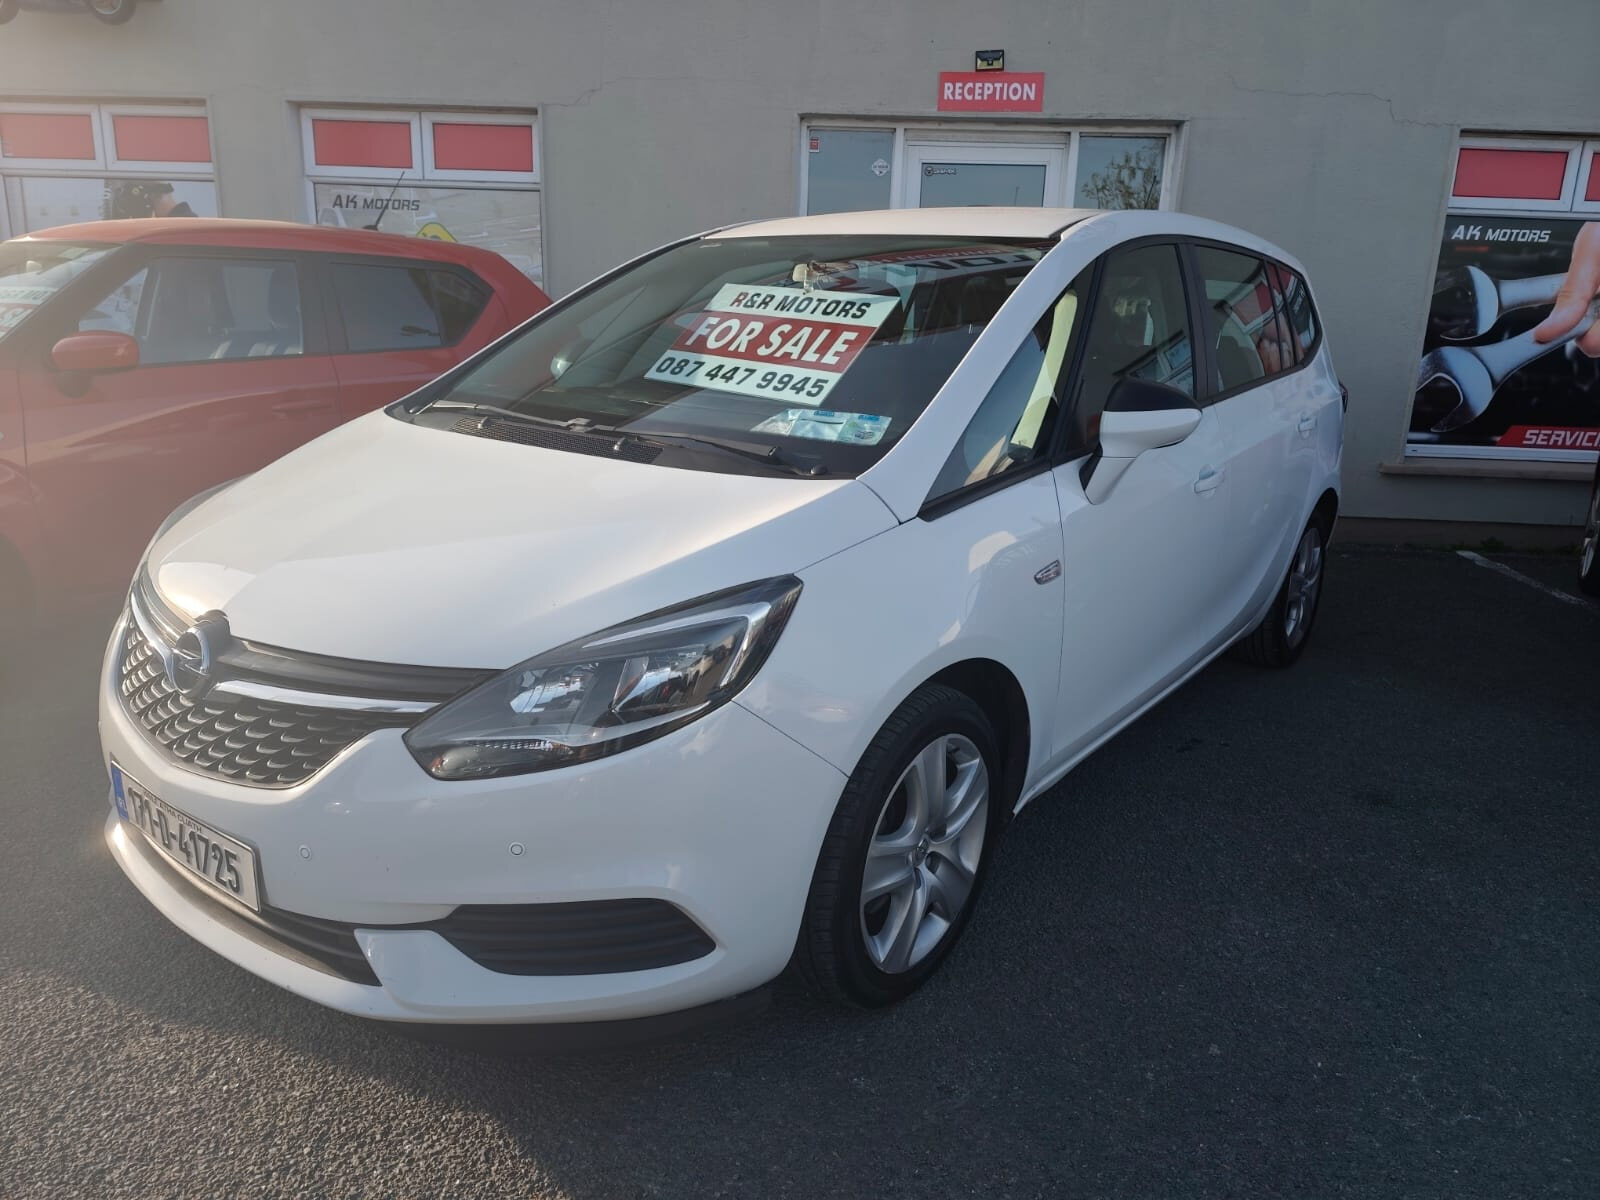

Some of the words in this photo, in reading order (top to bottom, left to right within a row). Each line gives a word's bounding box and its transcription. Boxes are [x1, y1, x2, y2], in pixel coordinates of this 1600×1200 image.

[943, 82, 1036, 101] RECEPTION
[332, 194, 357, 209] AK
[362, 198, 420, 211] MOTORS
[1451, 224, 1482, 241] AK
[1485, 228, 1552, 243] MOTORS
[729, 291, 772, 310] R&R
[774, 295, 871, 319] MOTORS
[685, 316, 764, 353] FOR
[757, 323, 858, 366] SALE
[656, 357, 704, 377] 087
[705, 364, 757, 386] 447
[756, 371, 829, 398] 9945
